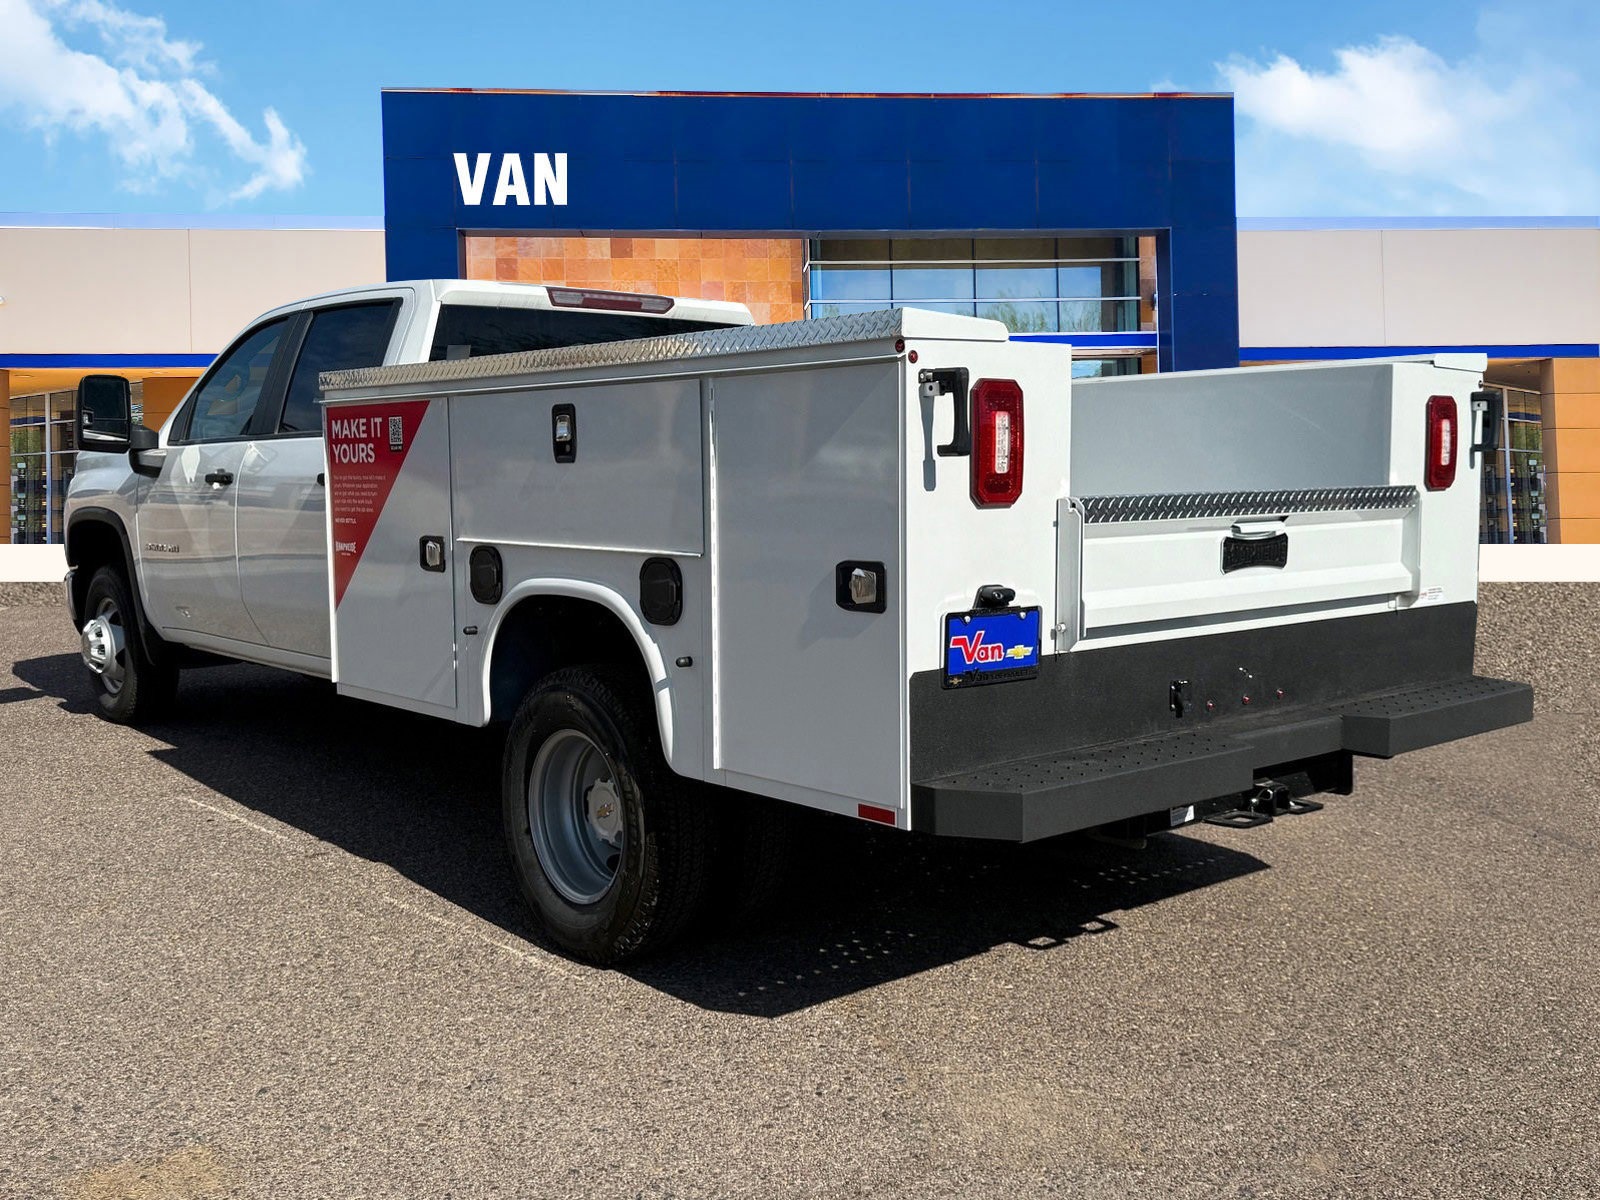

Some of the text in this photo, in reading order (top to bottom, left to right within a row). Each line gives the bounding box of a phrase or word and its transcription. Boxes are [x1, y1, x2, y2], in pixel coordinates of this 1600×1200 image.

[453, 152, 568, 206] VAN
[332, 417, 382, 439] MAKE IT
[332, 443, 375, 463] YOURS
[950, 630, 1004, 664] Van
